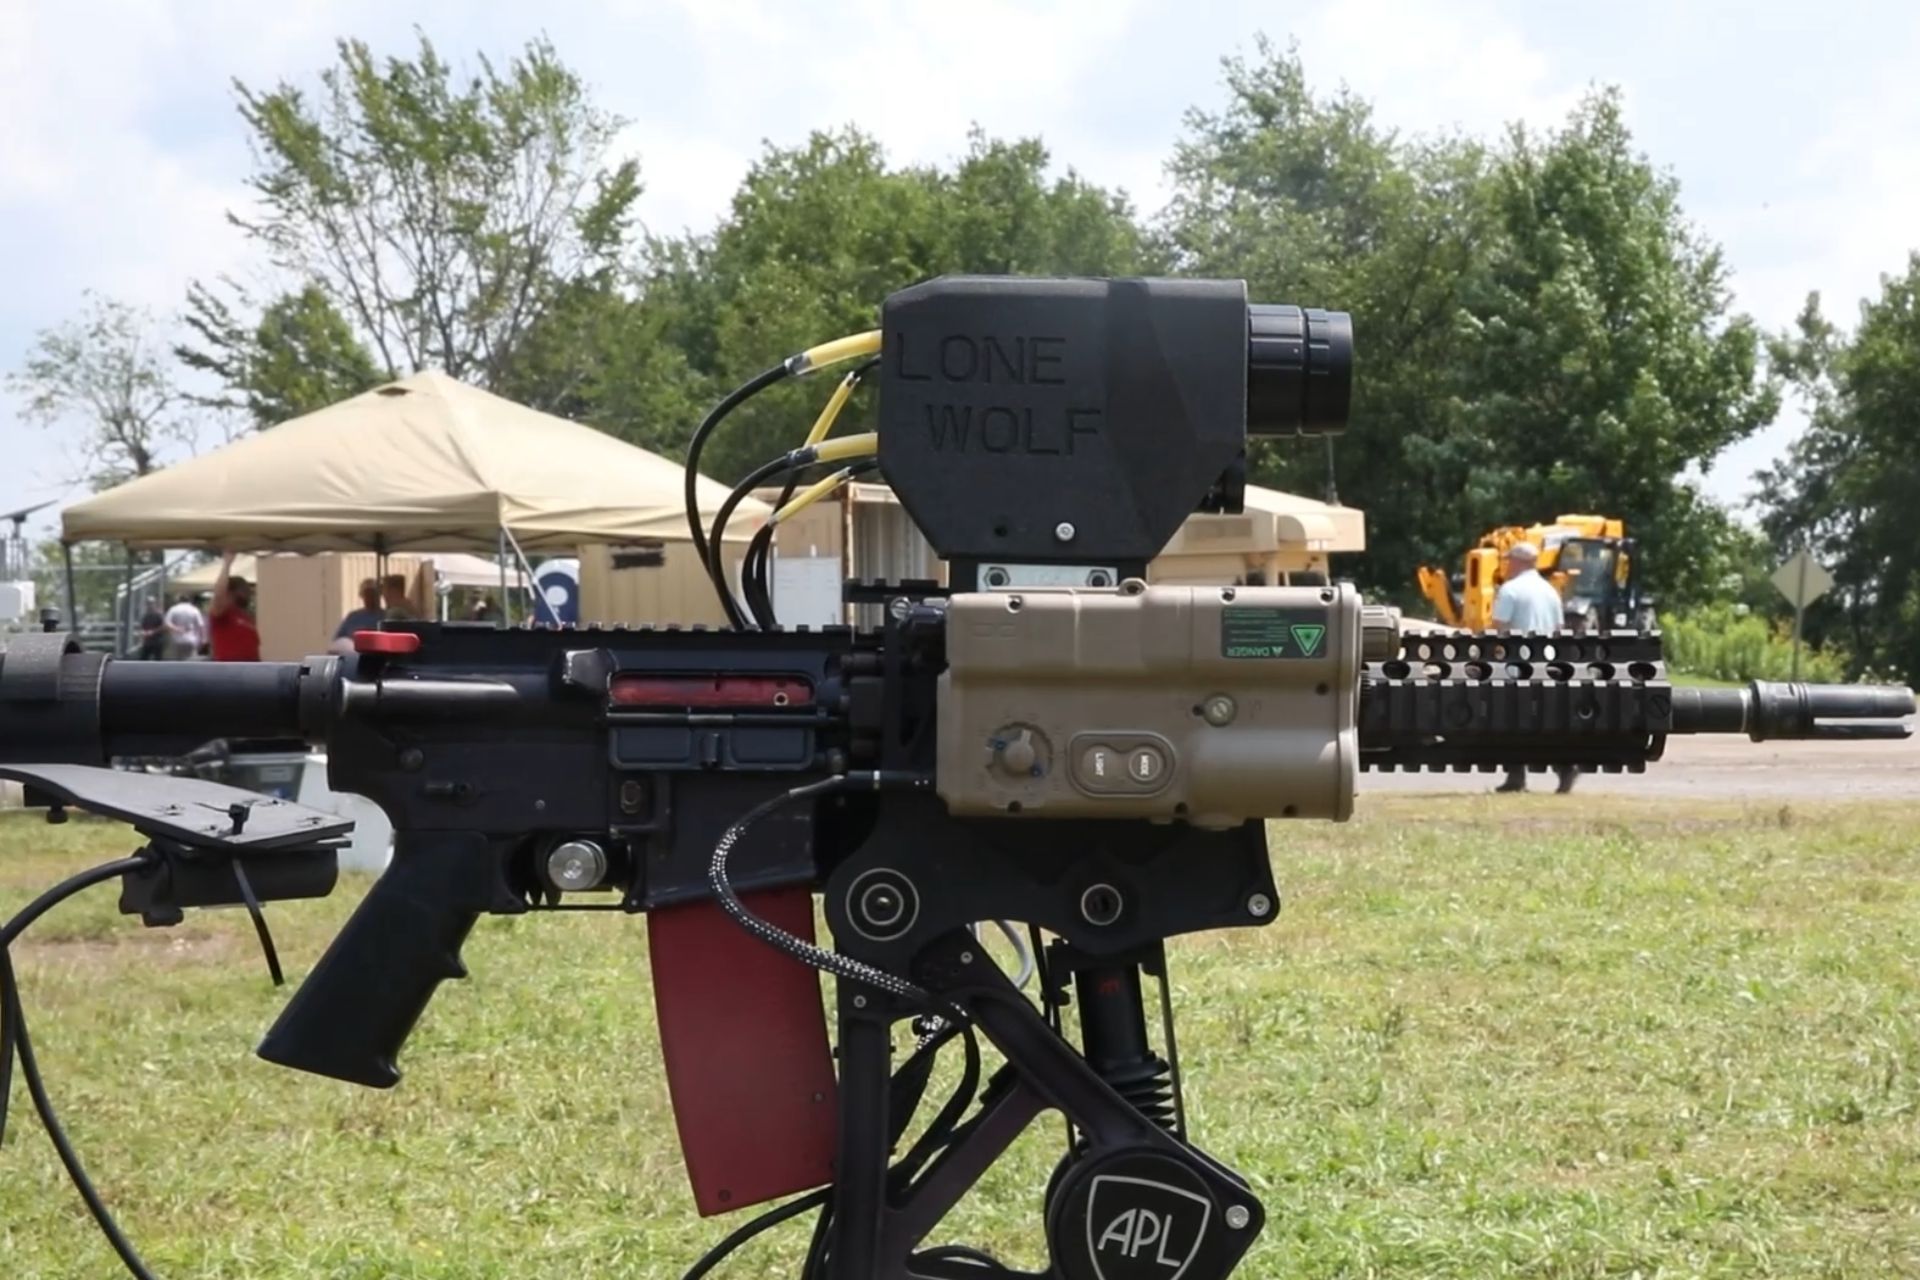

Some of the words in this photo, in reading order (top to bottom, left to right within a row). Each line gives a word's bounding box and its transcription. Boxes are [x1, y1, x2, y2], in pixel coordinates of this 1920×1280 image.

[896, 332, 1066, 385] LONE
[925, 404, 1102, 456] WOLF
[1098, 1208, 1182, 1267] APL
